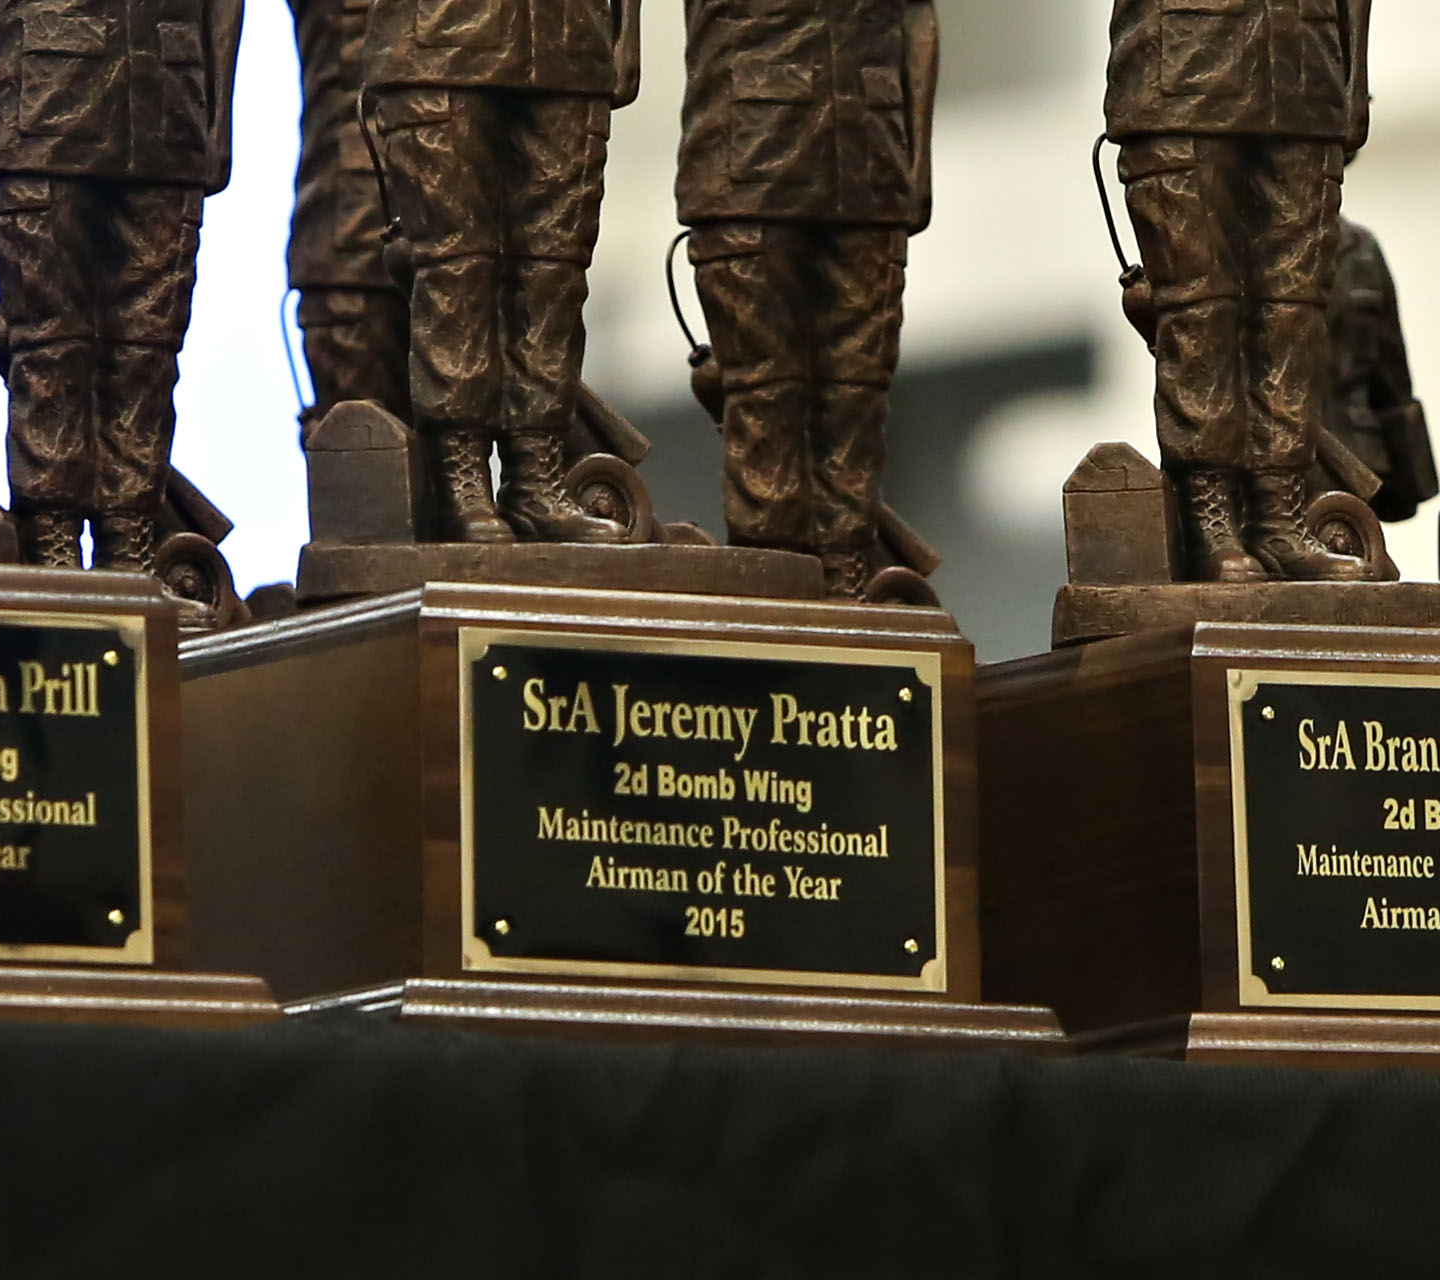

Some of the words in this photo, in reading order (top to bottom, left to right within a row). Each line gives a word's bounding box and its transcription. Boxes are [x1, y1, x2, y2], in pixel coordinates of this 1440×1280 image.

[21, 663, 99, 716] Prill
[523, 678, 600, 733] SrA
[612, 685, 758, 761] Jeremy
[770, 694, 897, 751] Pratta
[1299, 719, 1356, 770] SrA
[614, 763, 648, 795] 2d
[658, 765, 735, 800] Bomb
[744, 770, 812, 813] Wing
[538, 807, 713, 848] Maintenance
[723, 817, 888, 857] Professional
[1384, 798, 1415, 829] 2d
[586, 856, 688, 891] Airman
[697, 861, 726, 894] of
[733, 864, 775, 897] the
[784, 866, 841, 900] Year
[1297, 844, 1434, 878] Maintenance
[685, 907, 744, 938] 2015
